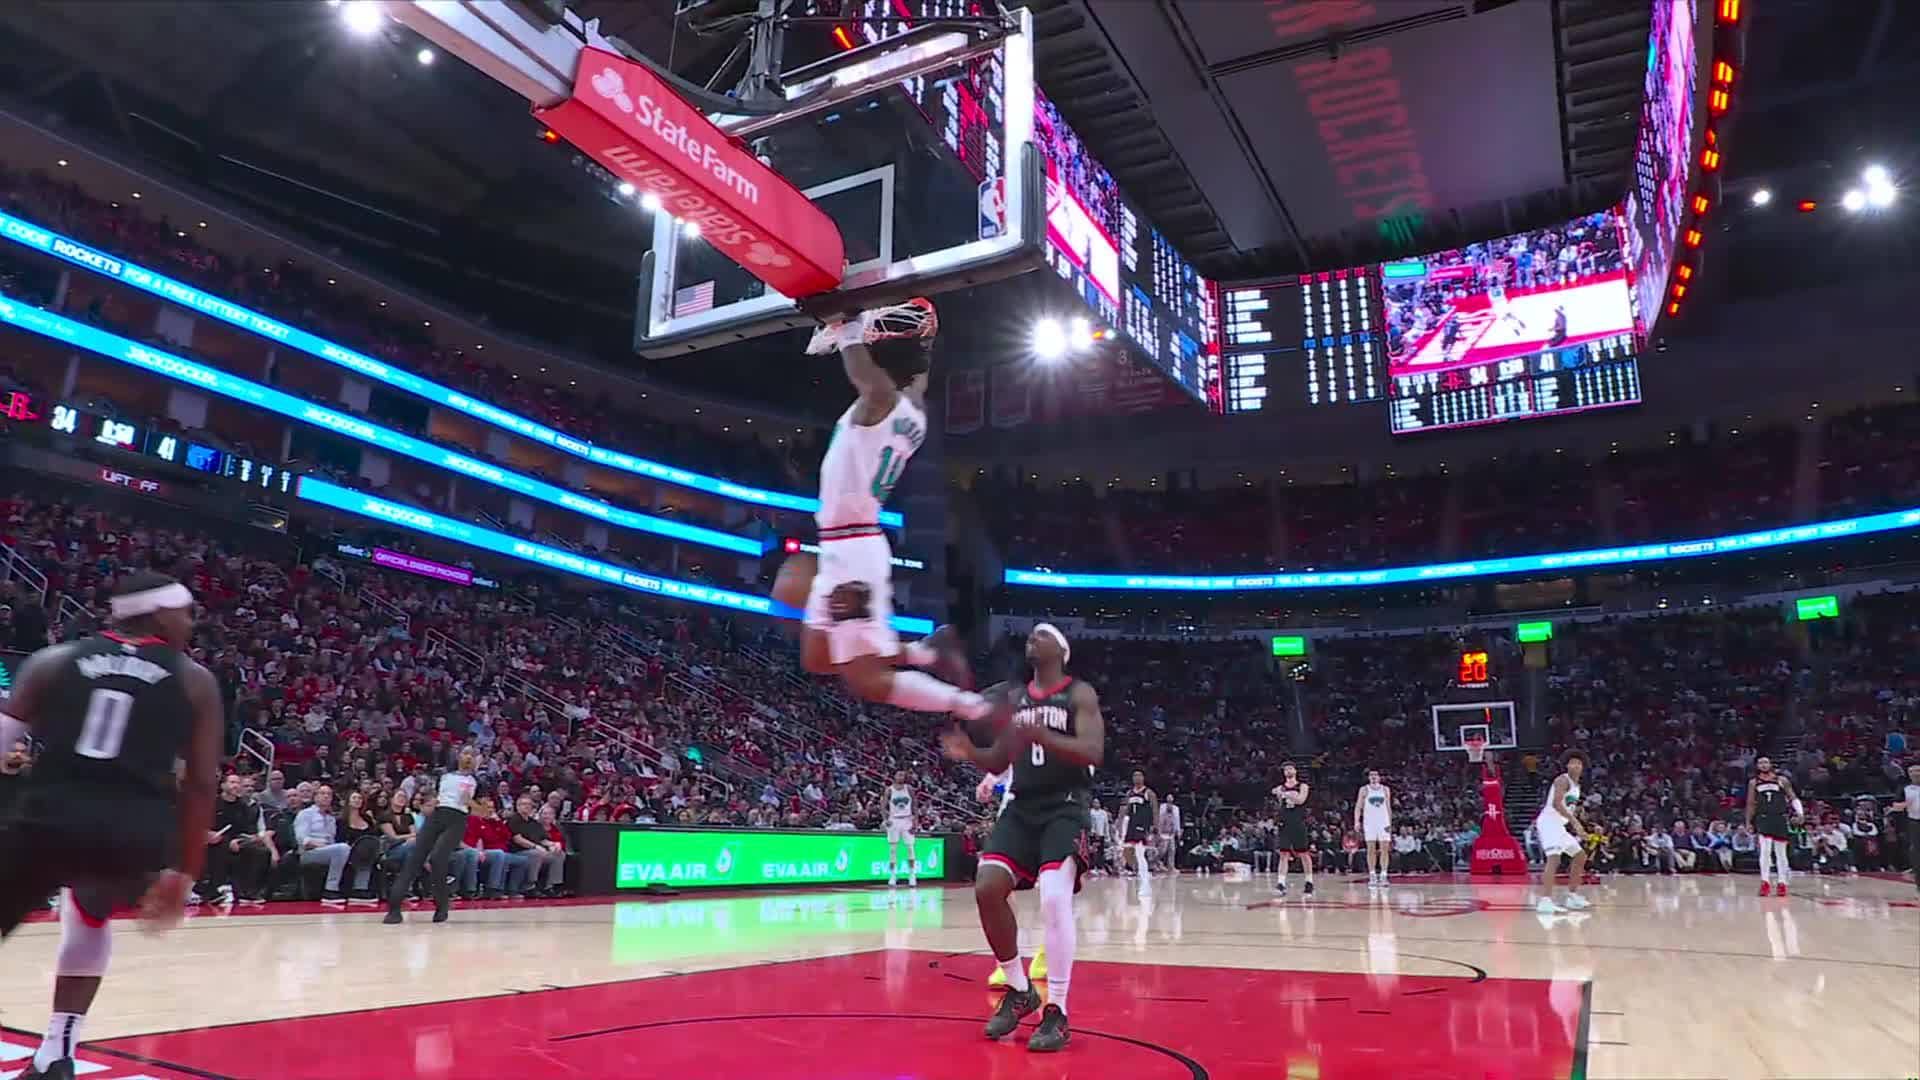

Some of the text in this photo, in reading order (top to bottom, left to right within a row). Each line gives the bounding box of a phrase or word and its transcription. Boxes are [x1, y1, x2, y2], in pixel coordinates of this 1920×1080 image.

[54, 239, 121, 275] ROCKETS
[125, 267, 152, 283] FOR
[164, 281, 195, 305] FREE
[197, 298, 248, 322] LOTTERY
[250, 316, 289, 339] TICKET
[51, 405, 77, 433] 34
[157, 436, 177, 461] 41
[623, 572, 662, 592] ROCKETS
[1461, 663, 1487, 682] 20
[74, 687, 136, 760] 0
[621, 863, 707, 881] EVA AIR
[762, 863, 829, 878] EVA AIR
